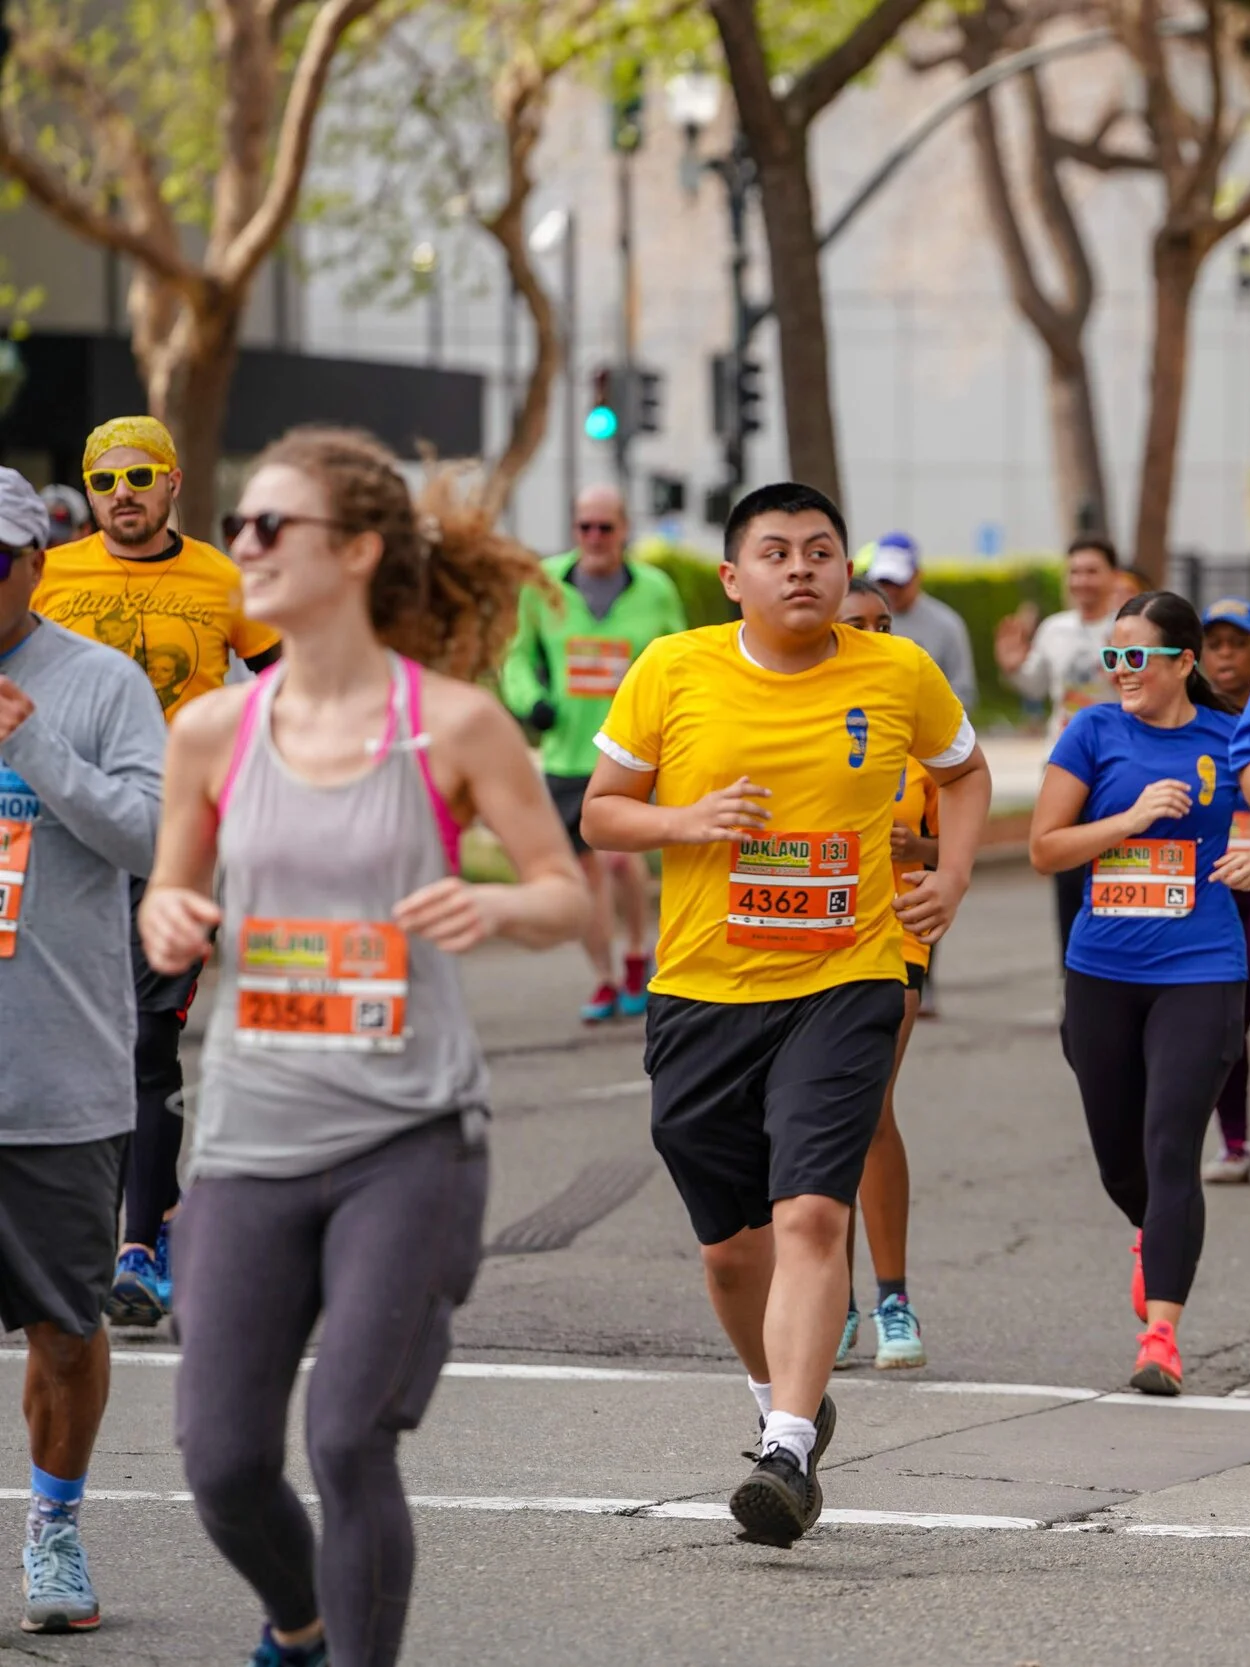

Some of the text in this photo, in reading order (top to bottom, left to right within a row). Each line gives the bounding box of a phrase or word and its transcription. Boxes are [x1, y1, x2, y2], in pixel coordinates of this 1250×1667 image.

[740, 834, 810, 858] OAKLAND
[821, 842, 848, 861] 13.1
[738, 888, 809, 914] 4362
[1098, 885, 1149, 905] 4291
